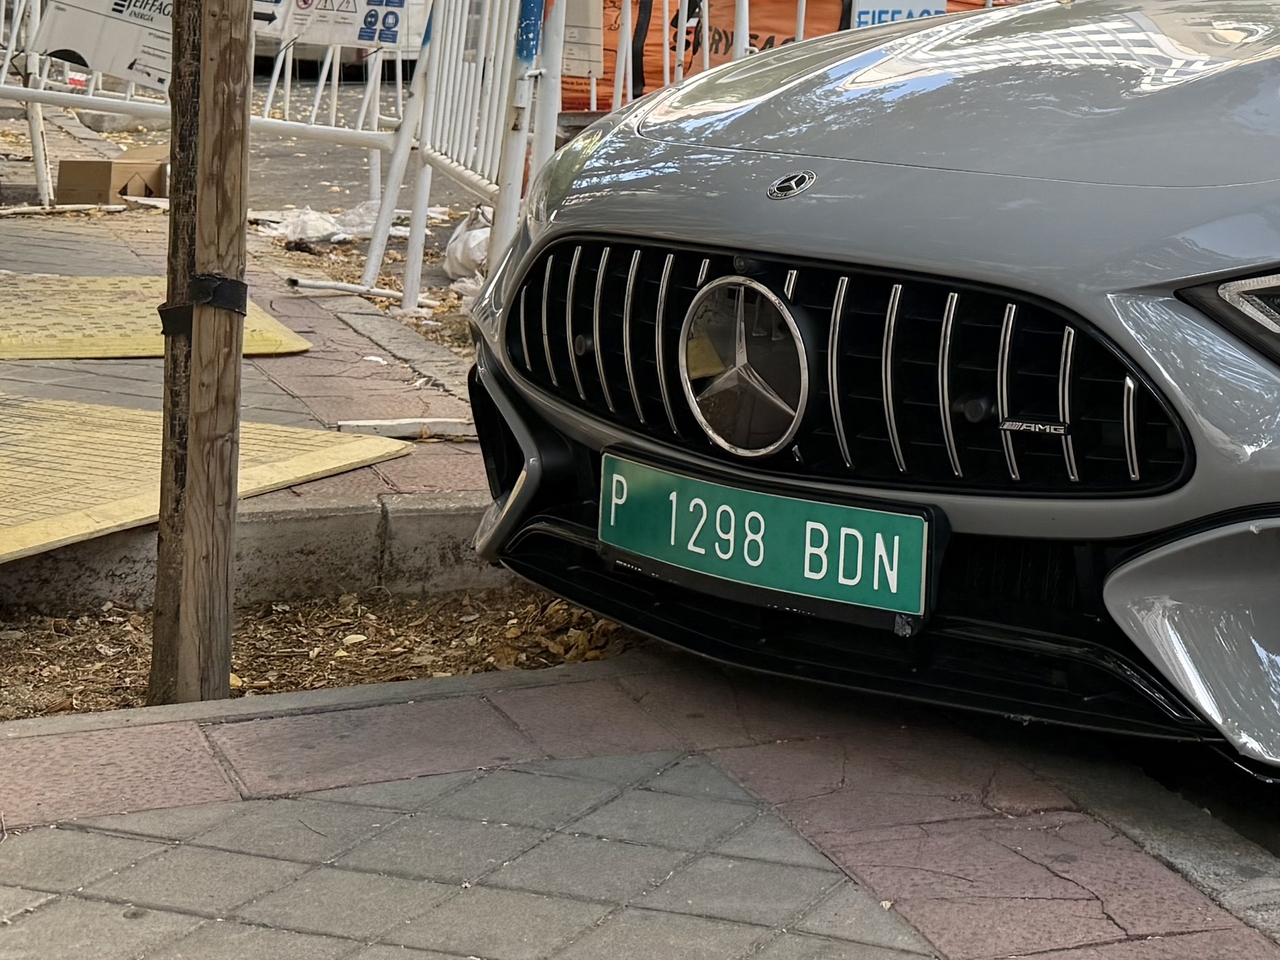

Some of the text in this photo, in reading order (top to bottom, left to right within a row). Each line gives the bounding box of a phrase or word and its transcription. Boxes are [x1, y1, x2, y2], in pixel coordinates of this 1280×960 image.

[1020, 422, 1065, 434] AMG
[610, 473, 900, 594] P 1298 BDN
